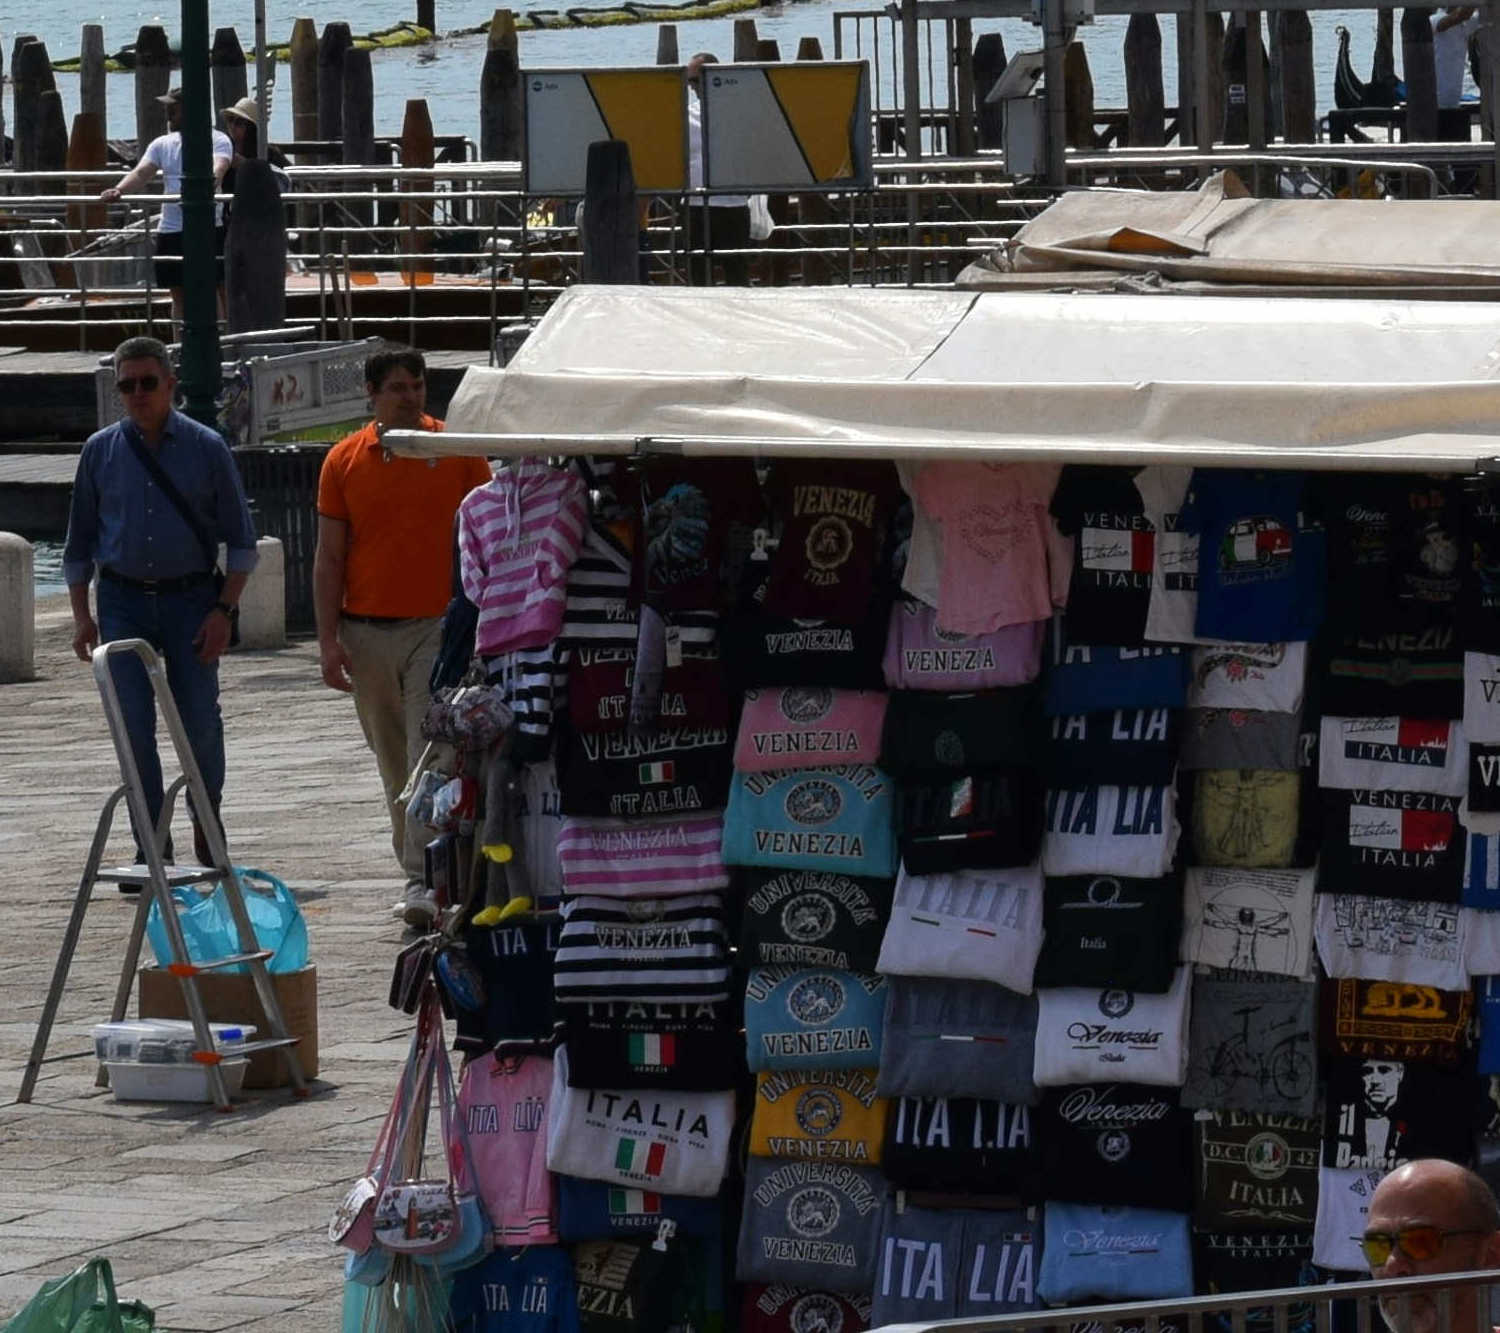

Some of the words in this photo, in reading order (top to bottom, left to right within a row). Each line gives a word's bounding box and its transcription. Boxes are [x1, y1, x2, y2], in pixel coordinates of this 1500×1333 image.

[793, 485, 877, 529] VENEZIA
[1346, 503, 1389, 521] Vene
[1084, 511, 1156, 532] VENEZ
[803, 568, 841, 586] ITALIA
[1095, 570, 1152, 590] ITALI
[766, 628, 854, 654] VENEZIA
[904, 645, 996, 674] VENEZIA
[599, 694, 688, 720] ITIA
[581, 726, 728, 761] VENEZIA
[753, 730, 861, 754] VENEZIA
[1357, 743, 1433, 765] ITALIA
[610, 785, 702, 815] ITALIA
[1112, 785, 1164, 835] LIA
[1351, 790, 1456, 813] VENEZIA
[588, 827, 690, 852] VENEZIA
[754, 831, 866, 858] VENEZIA
[1361, 849, 1436, 867] ITALIA
[893, 873, 1033, 930] ITALIA
[488, 926, 529, 959] ITA
[593, 925, 695, 951] VENEZIA
[1079, 935, 1108, 950] Italia
[758, 942, 849, 967] VENEZIA
[587, 1003, 717, 1020] ITALIA
[764, 1029, 872, 1057] VENEZIA
[1067, 1021, 1164, 1047] Venezia
[1099, 1053, 1126, 1063] Italia
[1339, 1041, 1459, 1061] VENEZIA
[634, 1065, 669, 1074] VENEZIA
[587, 1090, 709, 1139] ITALIA
[1058, 1086, 1172, 1123] Venezia
[467, 1104, 499, 1134] ITA
[1338, 1103, 1355, 1137] il
[768, 1137, 869, 1161] VENEZIA
[1209, 1144, 1242, 1161] D.C.
[619, 1169, 653, 1183] VENEZIA
[1229, 1179, 1305, 1208] ITALIA
[610, 1216, 661, 1228] VENEZIA
[763, 1237, 857, 1267] VENEZIA
[1063, 1230, 1161, 1250] Venezia
[1208, 1235, 1316, 1250] VENEZIA
[1231, 1248, 1299, 1258] ITALIA
[882, 1237, 946, 1303] ITA
[968, 1244, 1035, 1305] LIA
[482, 1284, 510, 1314] ITA
[522, 1284, 548, 1314] LIA
[577, 1284, 635, 1320] EZIA
